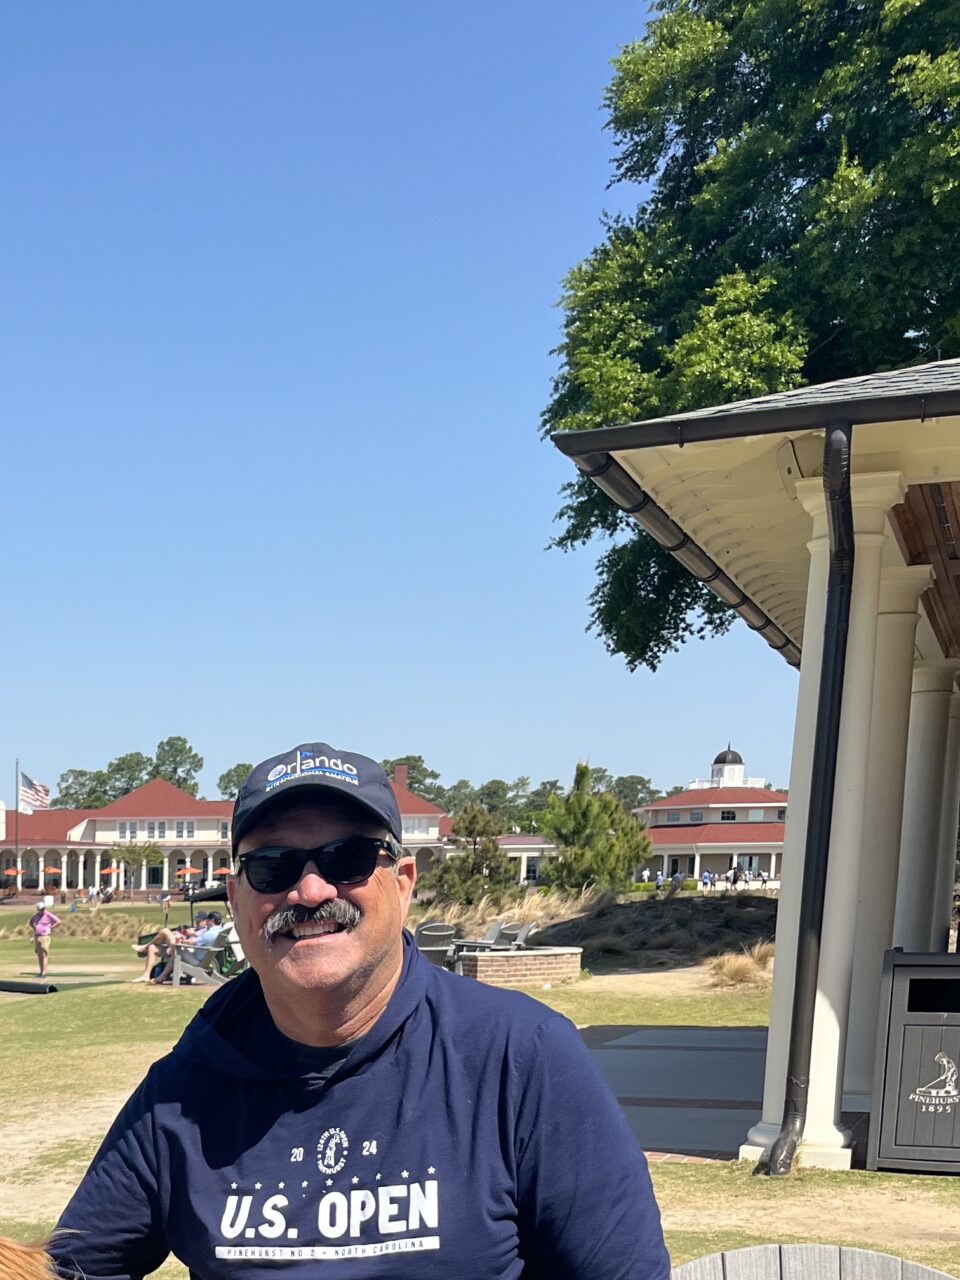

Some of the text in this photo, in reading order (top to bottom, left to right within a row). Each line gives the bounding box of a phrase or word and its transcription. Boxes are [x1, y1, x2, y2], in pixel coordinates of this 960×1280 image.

[267, 751, 357, 781] Orlando
[325, 771, 359, 786] AMATEUR
[909, 1093, 960, 1104] PINEHURS
[921, 1105, 951, 1113] 1895
[317, 1131, 330, 1151] 124TH
[290, 1140, 378, 1162] 20 24
[220, 1180, 439, 1239] U.S. OPEN
[227, 1248, 283, 1257] PINEHURST
[310, 1249, 315, 1257] 2
[335, 1247, 366, 1256] NORTH
[373, 1240, 424, 1254] CAROLINA
